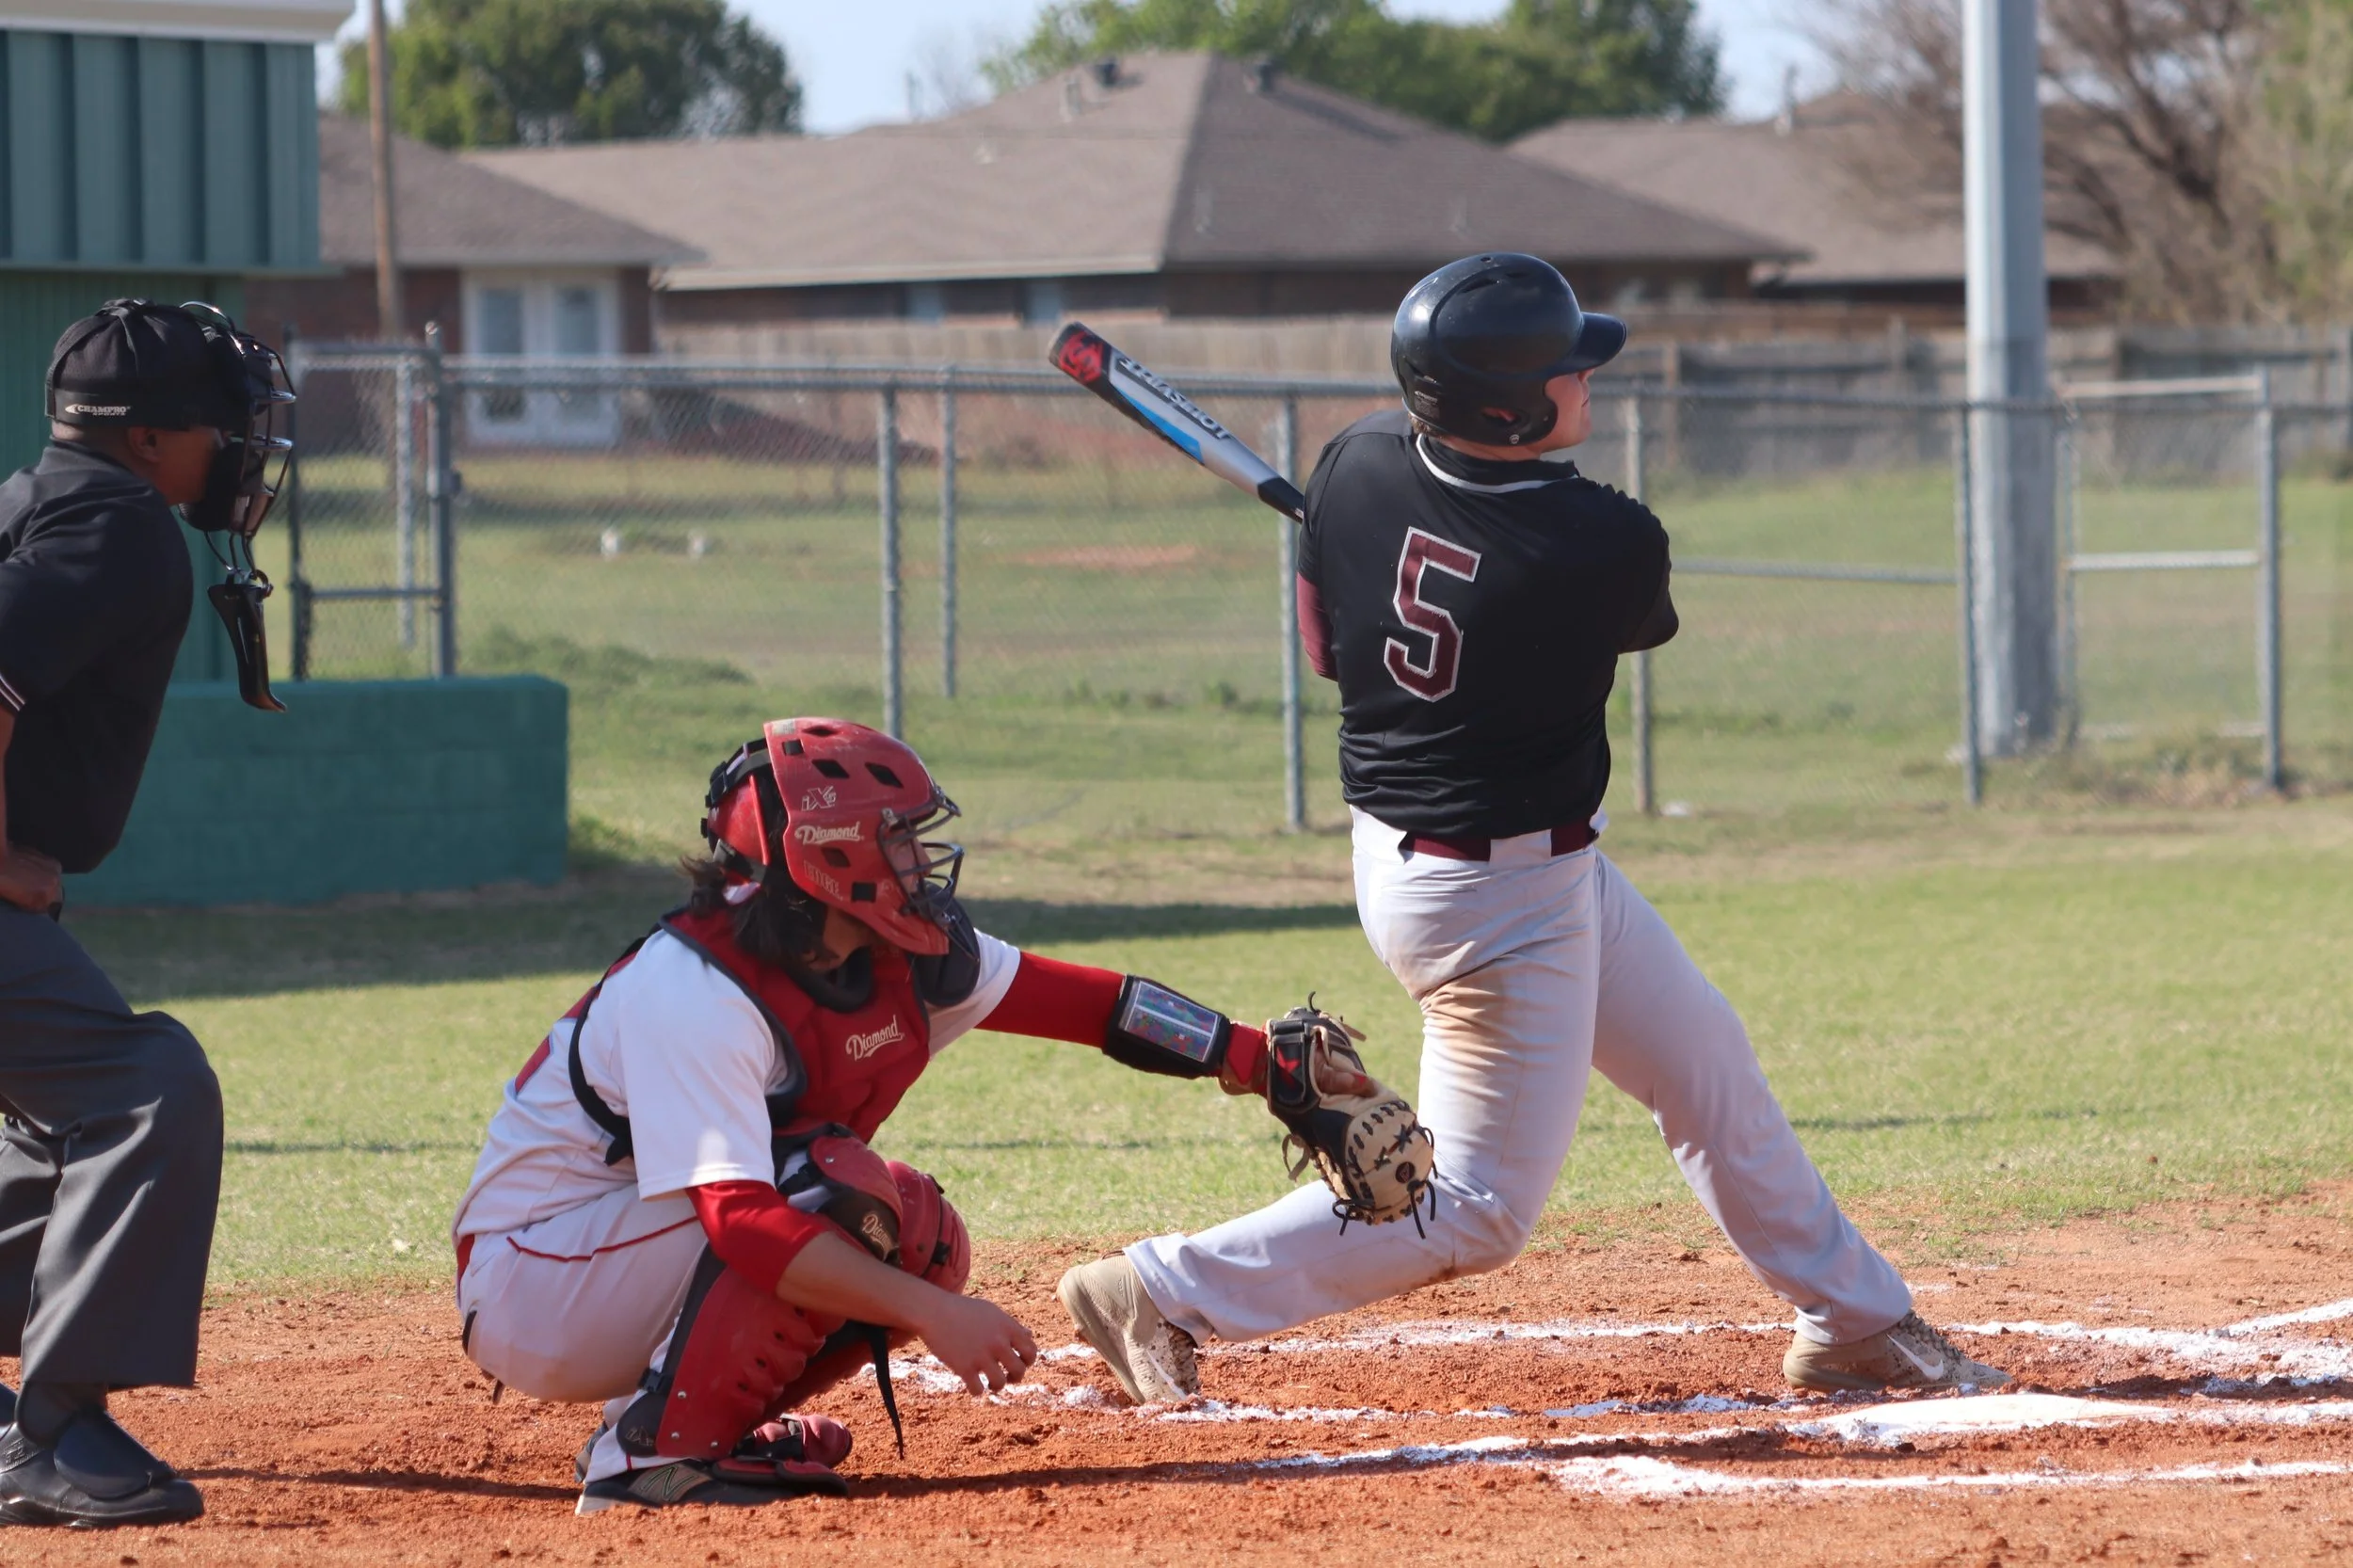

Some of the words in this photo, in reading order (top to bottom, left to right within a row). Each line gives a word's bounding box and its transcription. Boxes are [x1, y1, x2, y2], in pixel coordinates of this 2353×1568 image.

[77, 405, 127, 413] CHAMPRO
[1384, 526, 1482, 703] 5
[794, 821, 861, 846] Diamond
[845, 1014, 904, 1062] Diamond
